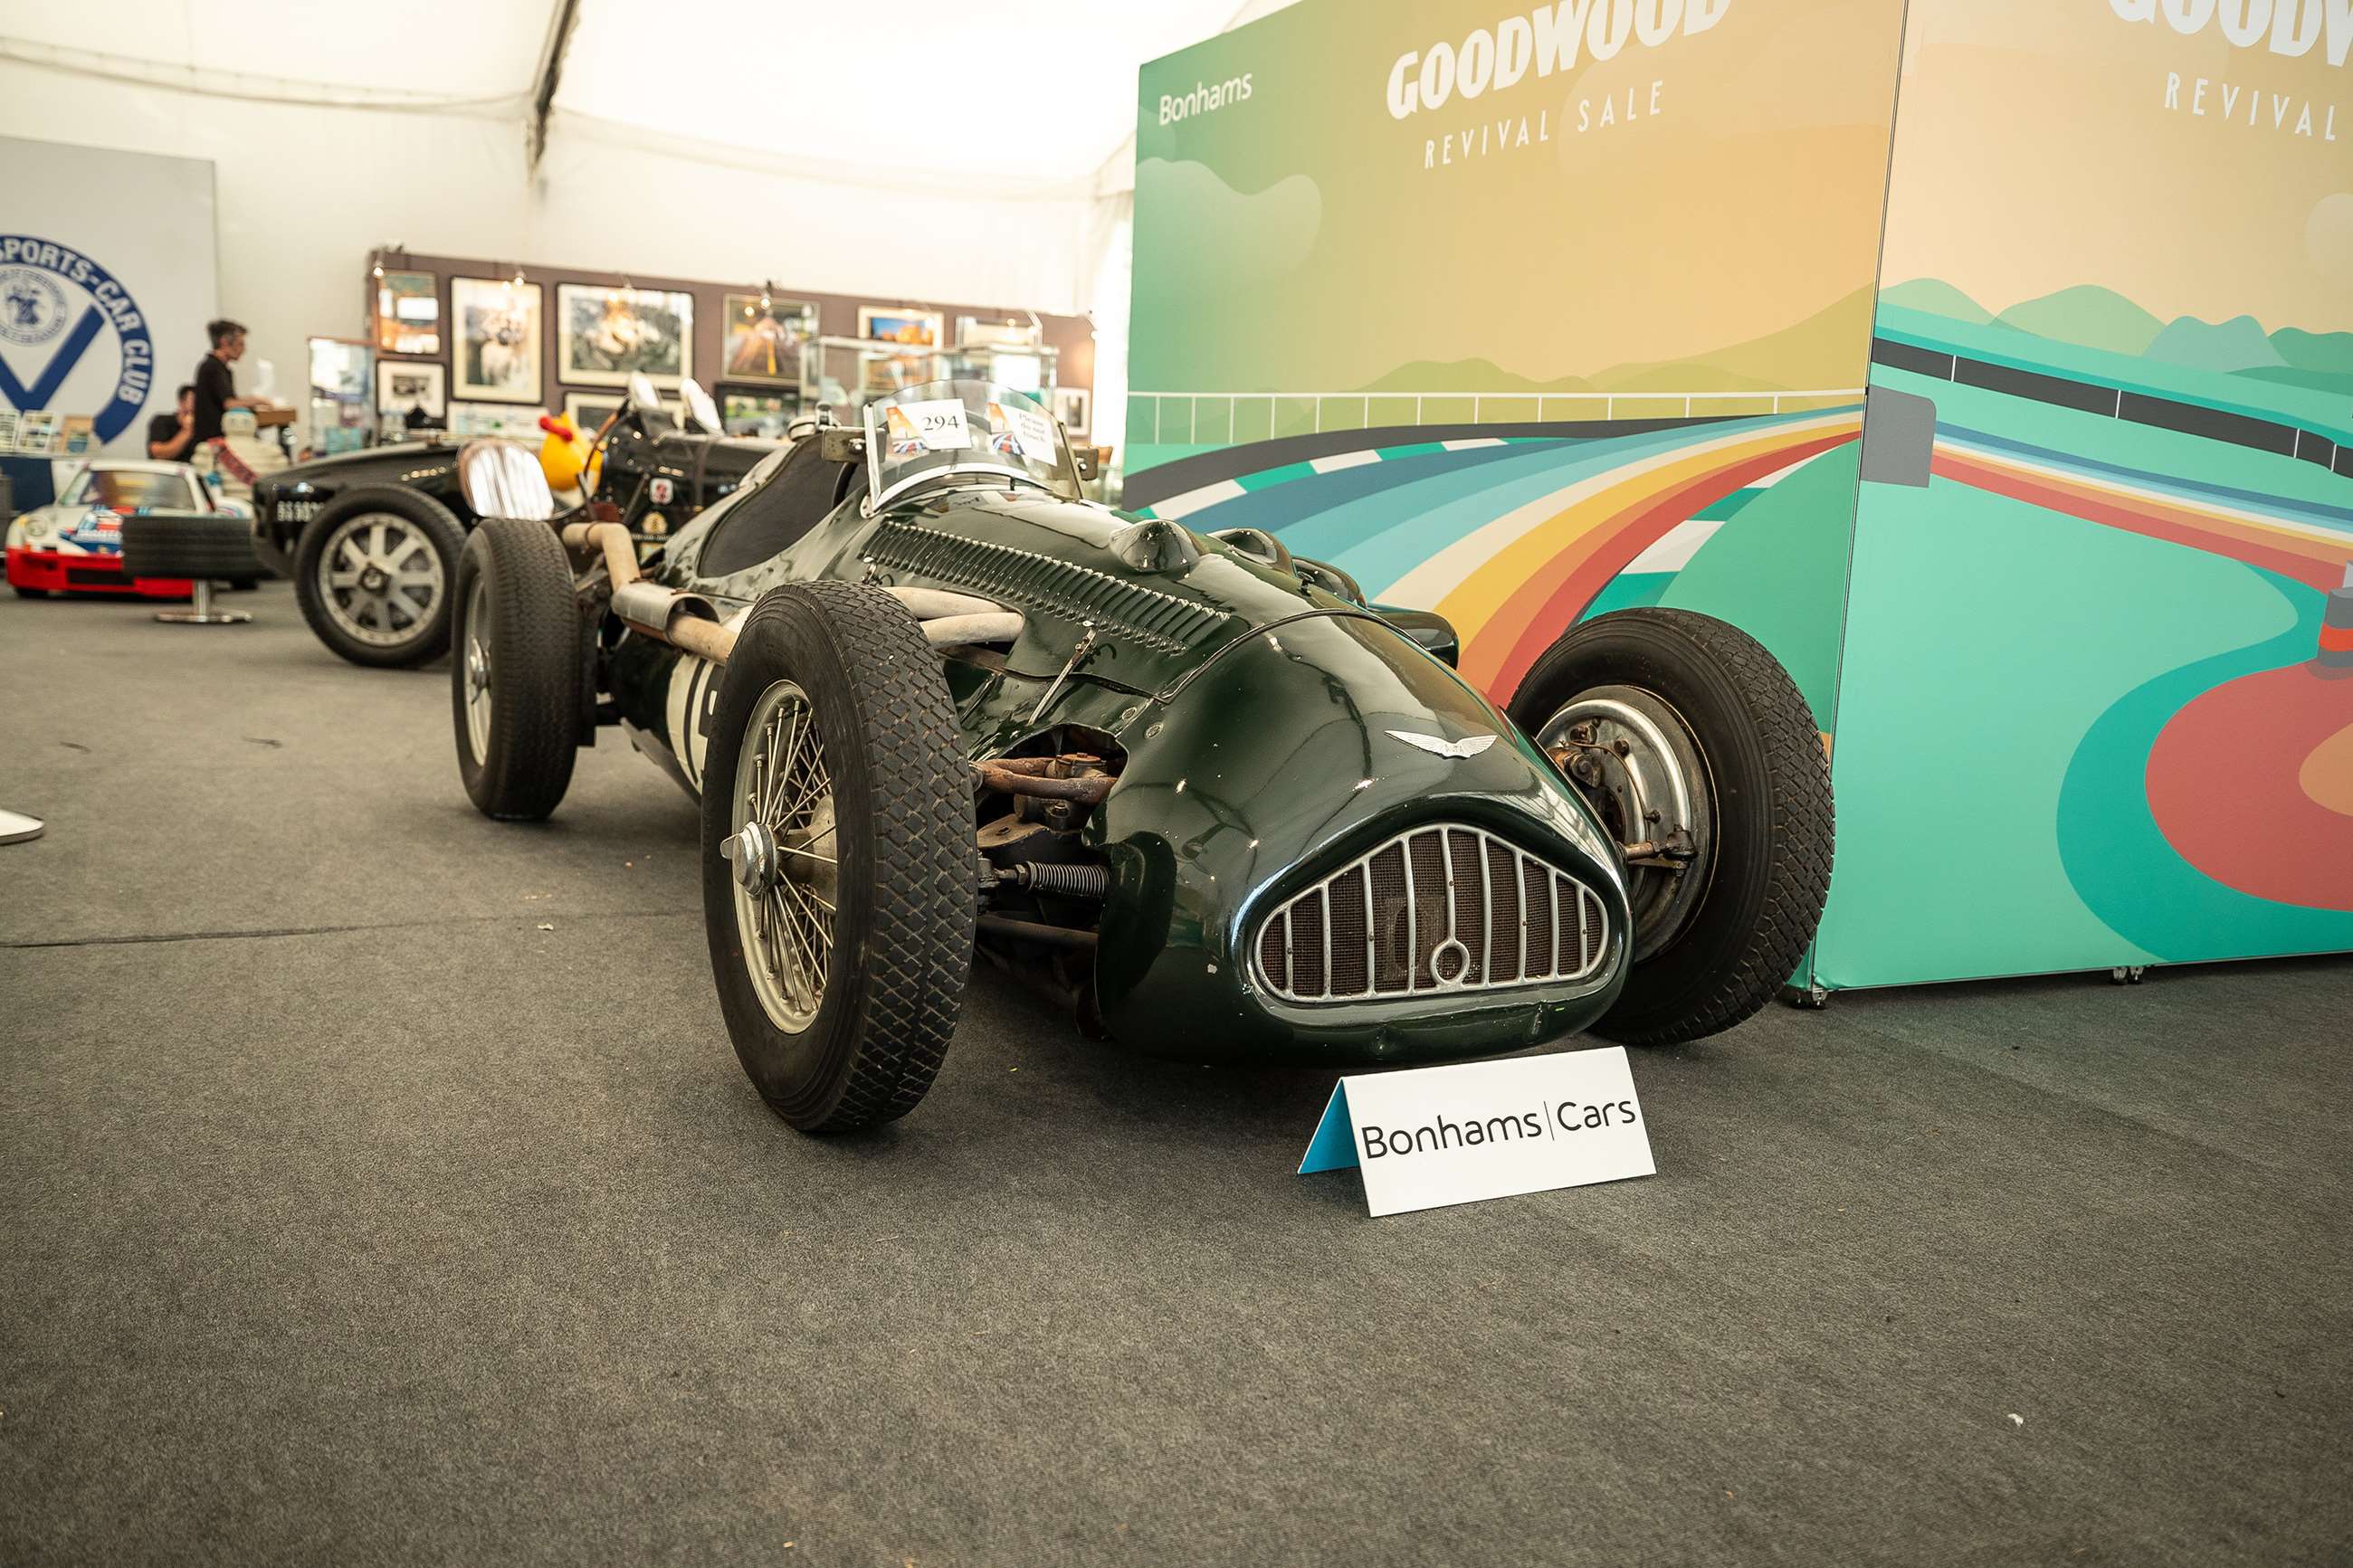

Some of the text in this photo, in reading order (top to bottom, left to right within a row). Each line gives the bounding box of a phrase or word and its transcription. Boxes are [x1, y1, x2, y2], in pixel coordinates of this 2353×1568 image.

[1158, 72, 1253, 126] Bonhams
[1424, 80, 1664, 170] REVIVAL SALE
[2164, 71, 2337, 141] REVIVAL
[117, 338, 151, 406] CLUB
[921, 415, 960, 432] 294
[1361, 1100, 1636, 1160] Bonhams Cars
